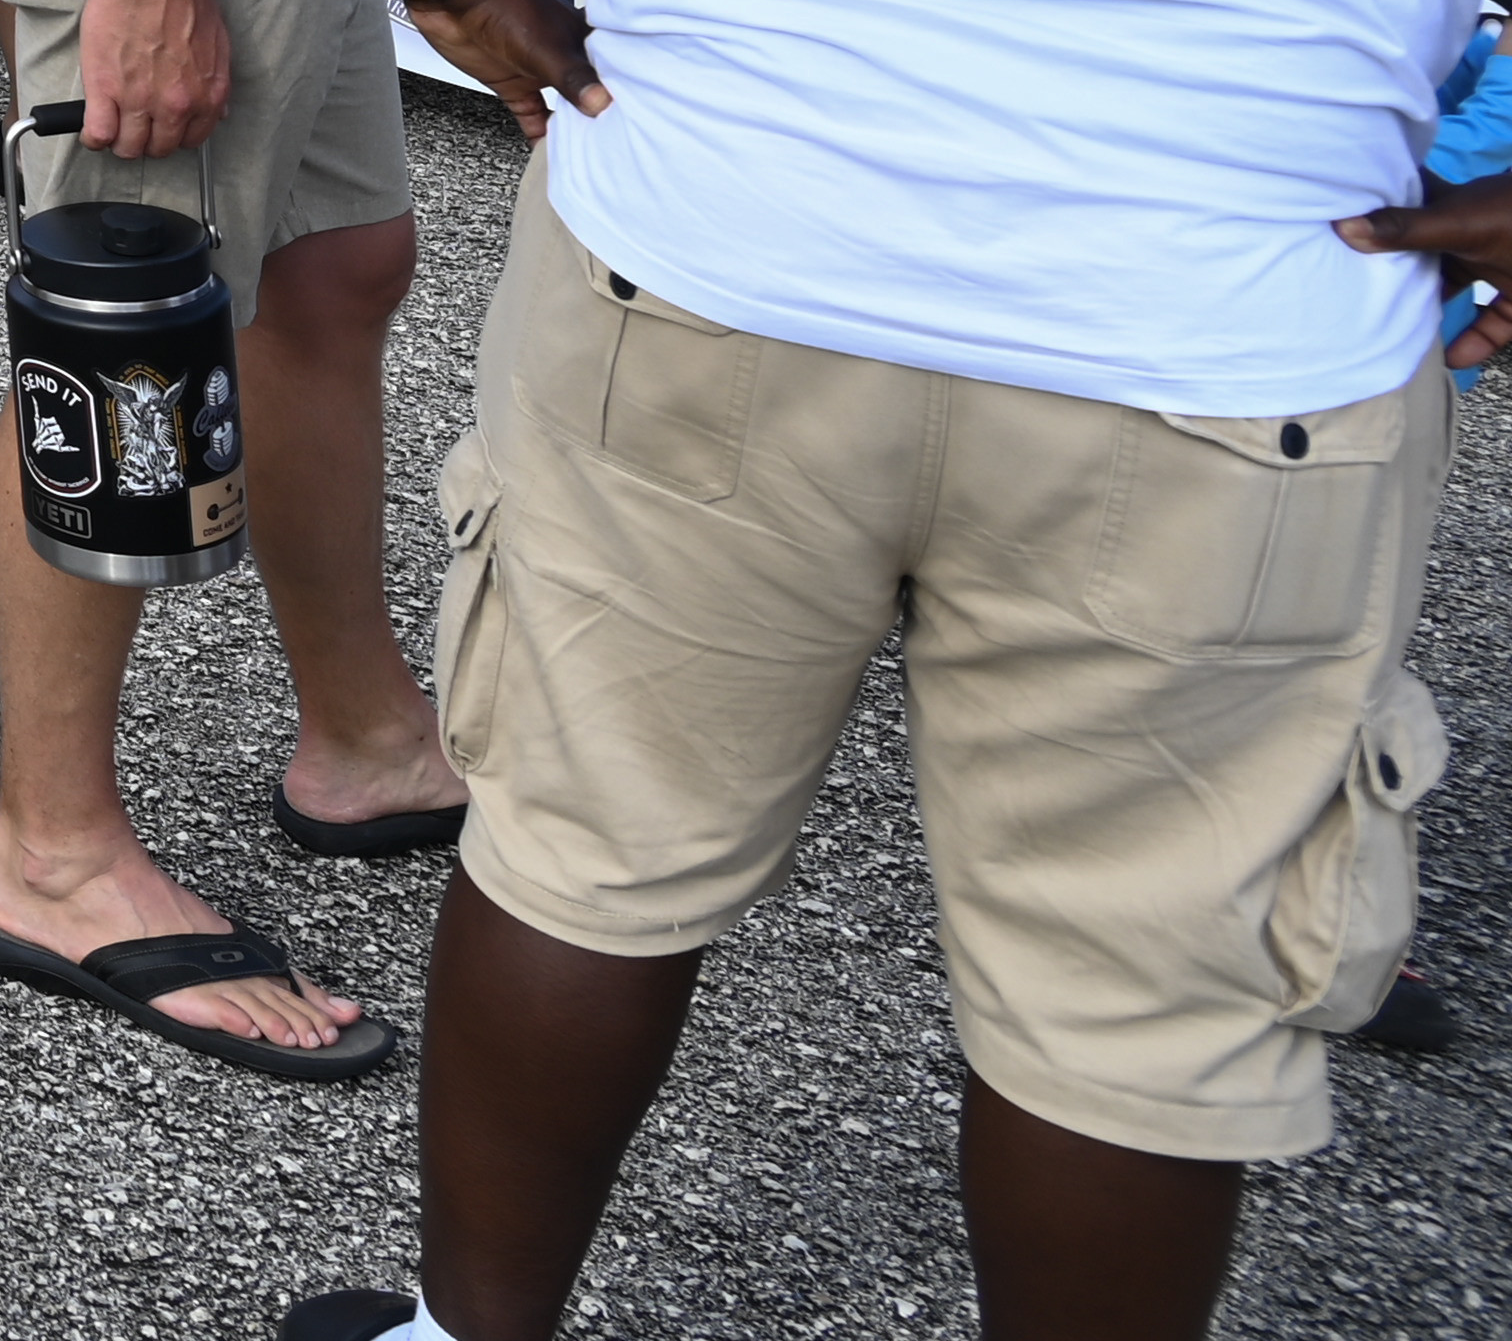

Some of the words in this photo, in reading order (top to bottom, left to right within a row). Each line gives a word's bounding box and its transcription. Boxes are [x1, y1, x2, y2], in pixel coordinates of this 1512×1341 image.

[21, 373, 58, 395] SEND
[62, 389, 83, 407] IT
[35, 497, 84, 532] YETI
